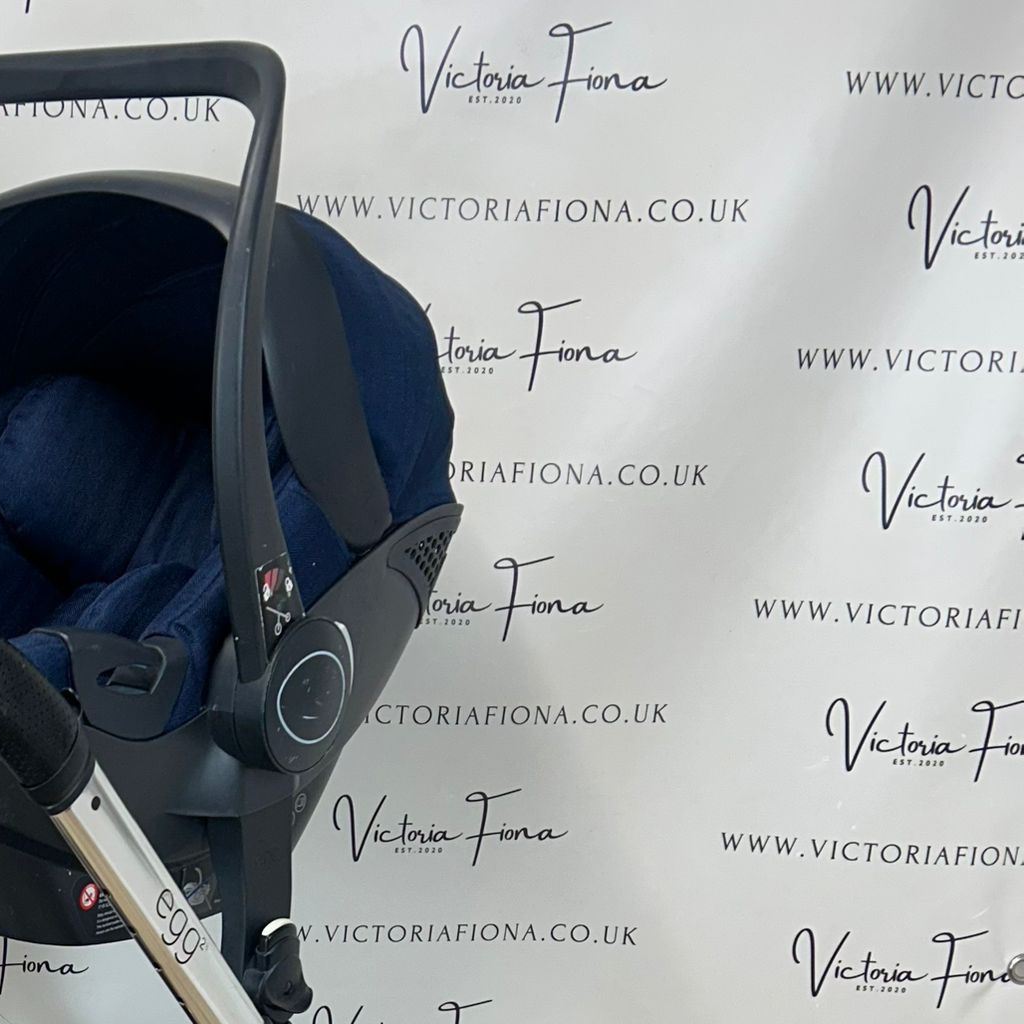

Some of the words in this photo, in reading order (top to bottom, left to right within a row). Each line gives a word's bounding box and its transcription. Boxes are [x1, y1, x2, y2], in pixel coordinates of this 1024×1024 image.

[399, 24, 546, 115] Victoria
[547, 20, 668, 124] Fiona
[468, 95, 522, 105] EST.2020
[517, 298, 638, 393] Fiona
[797, 347, 1024, 374] WWW.VICTORI
[861, 450, 1013, 531] Victoria
[493, 555, 605, 643] Fiona
[825, 697, 968, 773] Victoria
[332, 793, 464, 863] Victoria
[464, 787, 569, 867] Fiona
[721, 831, 1024, 867] WWW.VICTORIAFION
[791, 927, 929, 998] Victoria
